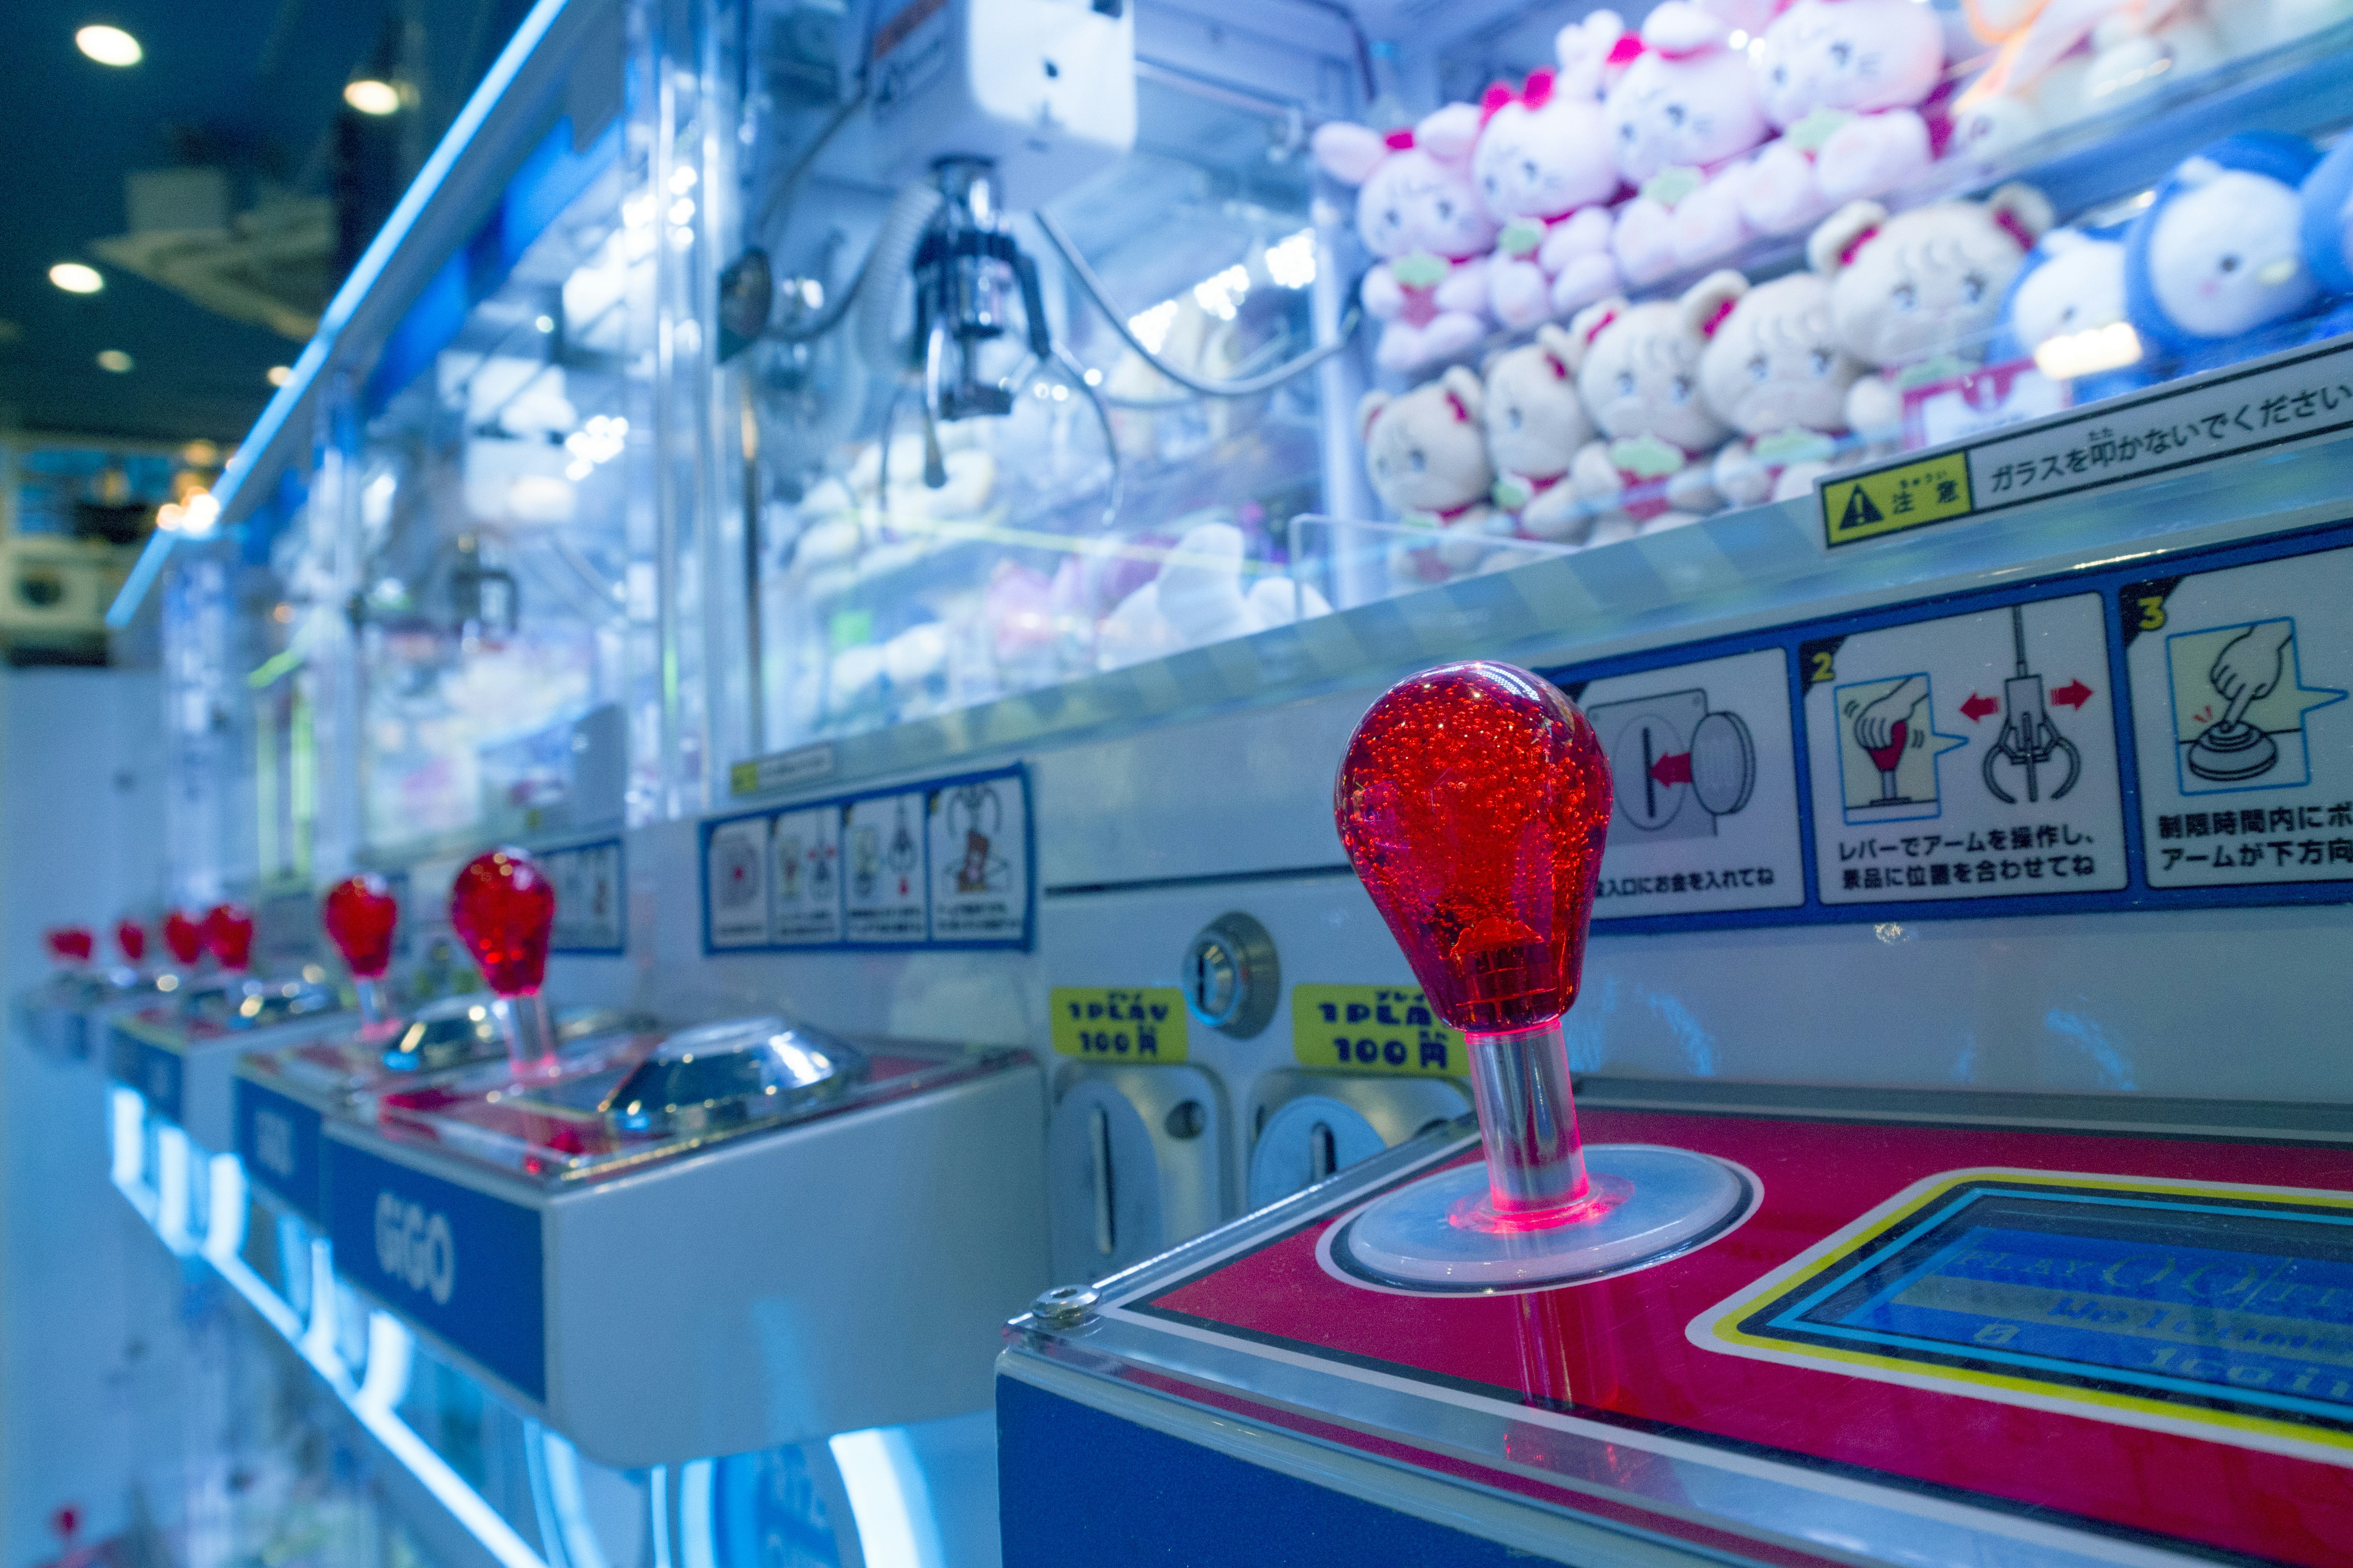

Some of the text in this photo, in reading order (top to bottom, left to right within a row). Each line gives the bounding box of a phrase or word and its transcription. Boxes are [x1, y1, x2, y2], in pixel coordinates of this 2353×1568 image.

[1991, 384, 2353, 493] ガラスを叩かないでください
[2137, 595, 2164, 630] 3
[1811, 651, 1835, 682] 2
[1319, 1002, 1433, 1027] 1PLA
